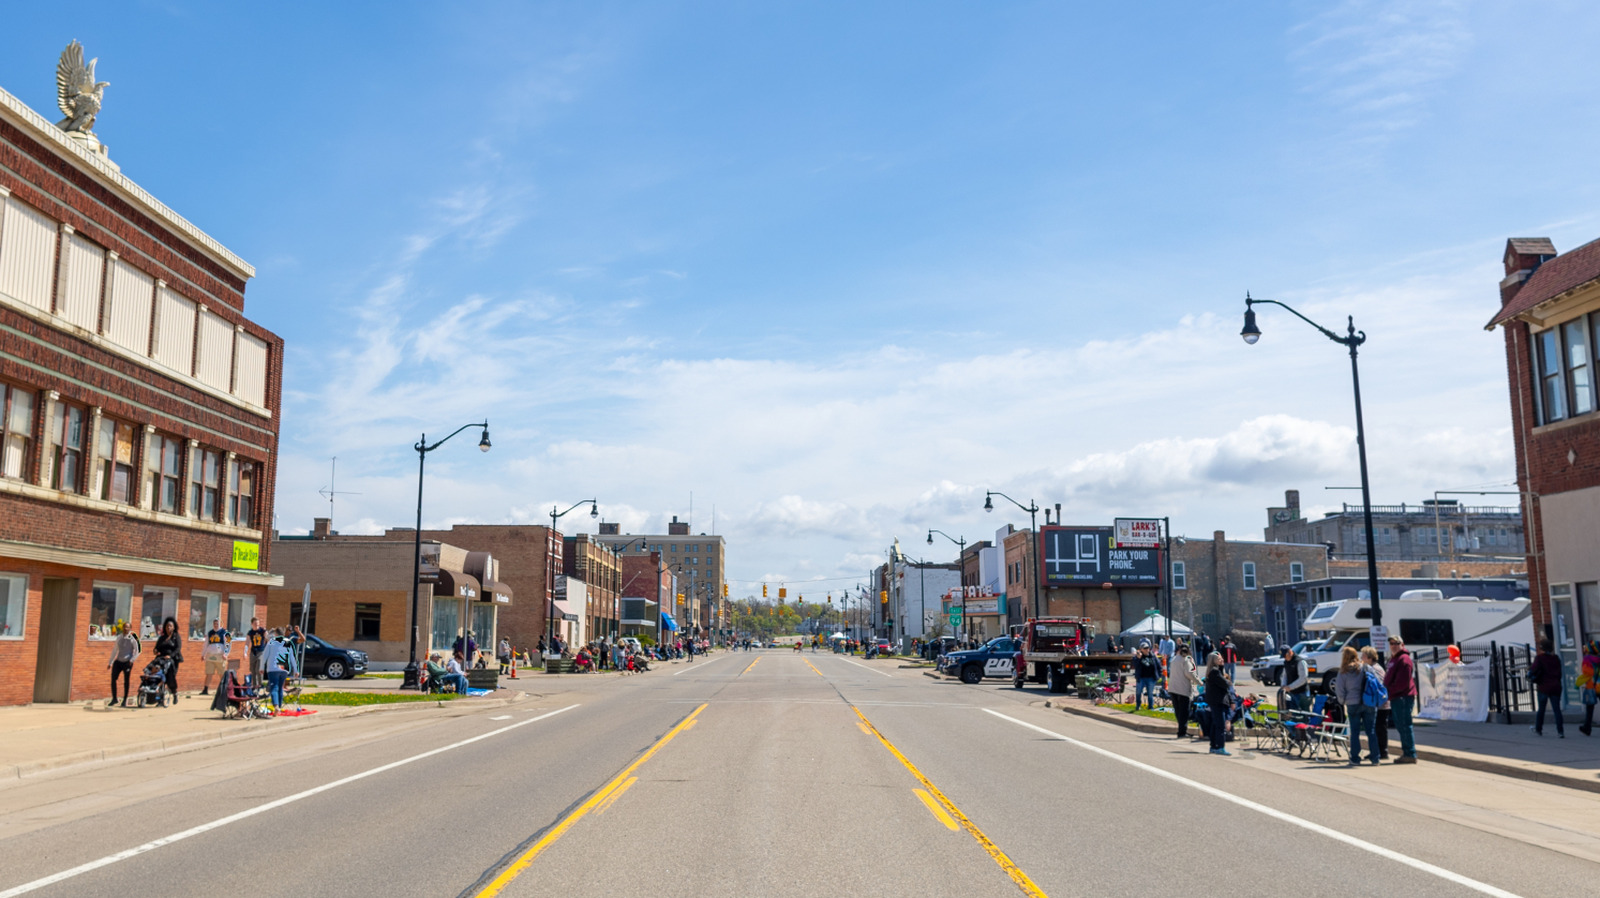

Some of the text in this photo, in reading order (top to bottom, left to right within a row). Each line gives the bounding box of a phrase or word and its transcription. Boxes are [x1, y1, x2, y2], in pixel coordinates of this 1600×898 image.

[1131, 522, 1156, 531] LARK'S
[1109, 550, 1149, 560] PARK YOUR
[1109, 560, 1135, 569] PHONE.
[985, 658, 1015, 668] POL
